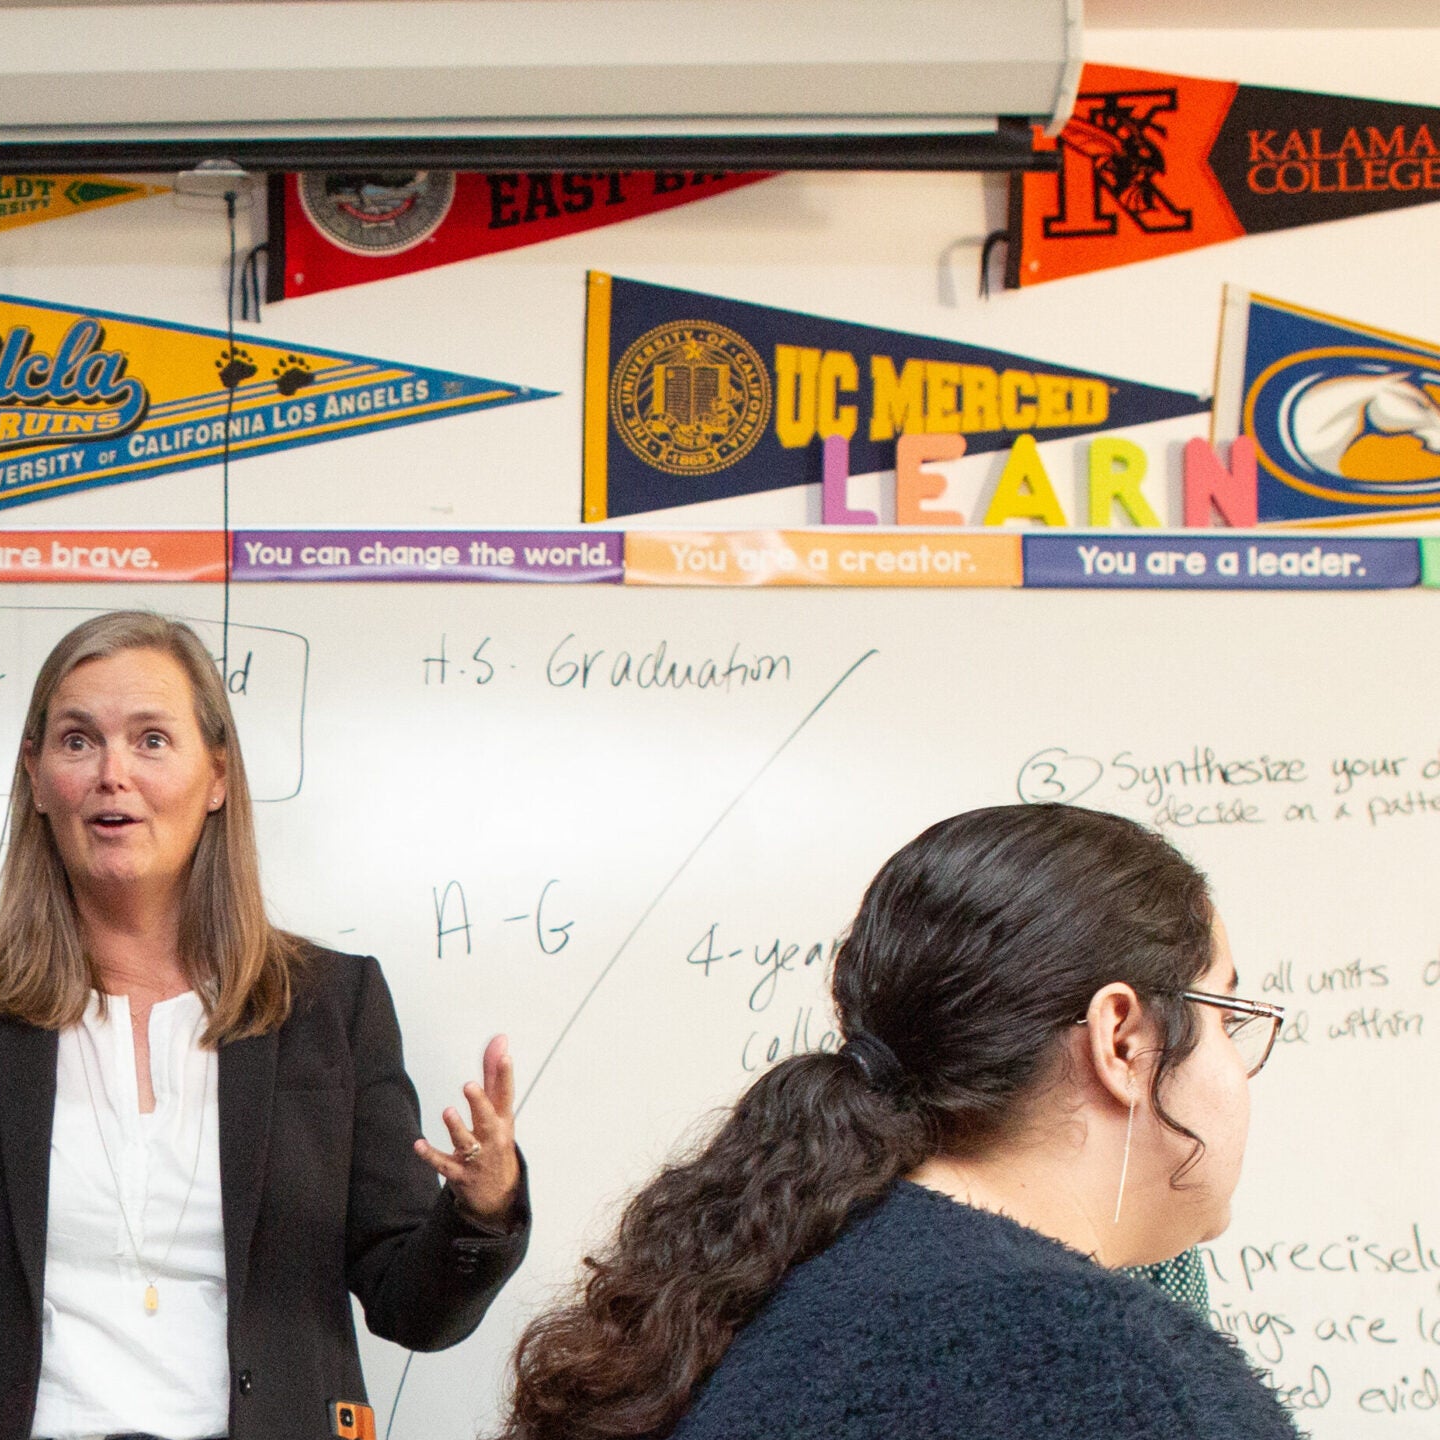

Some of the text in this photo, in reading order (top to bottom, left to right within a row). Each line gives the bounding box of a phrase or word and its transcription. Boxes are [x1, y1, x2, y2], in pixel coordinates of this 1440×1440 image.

[1246, 160, 1440, 195] COLLEGE
[486, 172, 628, 231] EAST
[622, 330, 694, 405] UNIVERSITY
[775, 343, 1109, 449] UC MERCED
[128, 414, 265, 458] CALIFORNIA
[273, 401, 317, 430] LOS
[324, 379, 429, 419] ANGELES
[823, 433, 1258, 528] LEARN
[51, 540, 159, 569] brave.
[245, 541, 613, 571] You can change the world.
[671, 544, 977, 574] You are a creator.
[1077, 545, 1368, 577] You are a leader.
[546, 633, 792, 693] Graduation
[1111, 744, 1308, 807] Synthesize
[1332, 756, 1408, 795] your
[1154, 794, 1266, 827] decide
[1262, 960, 1294, 994] all
[1308, 957, 1390, 994] units
[1328, 1006, 1424, 1040] within
[1315, 1314, 1398, 1344] are
